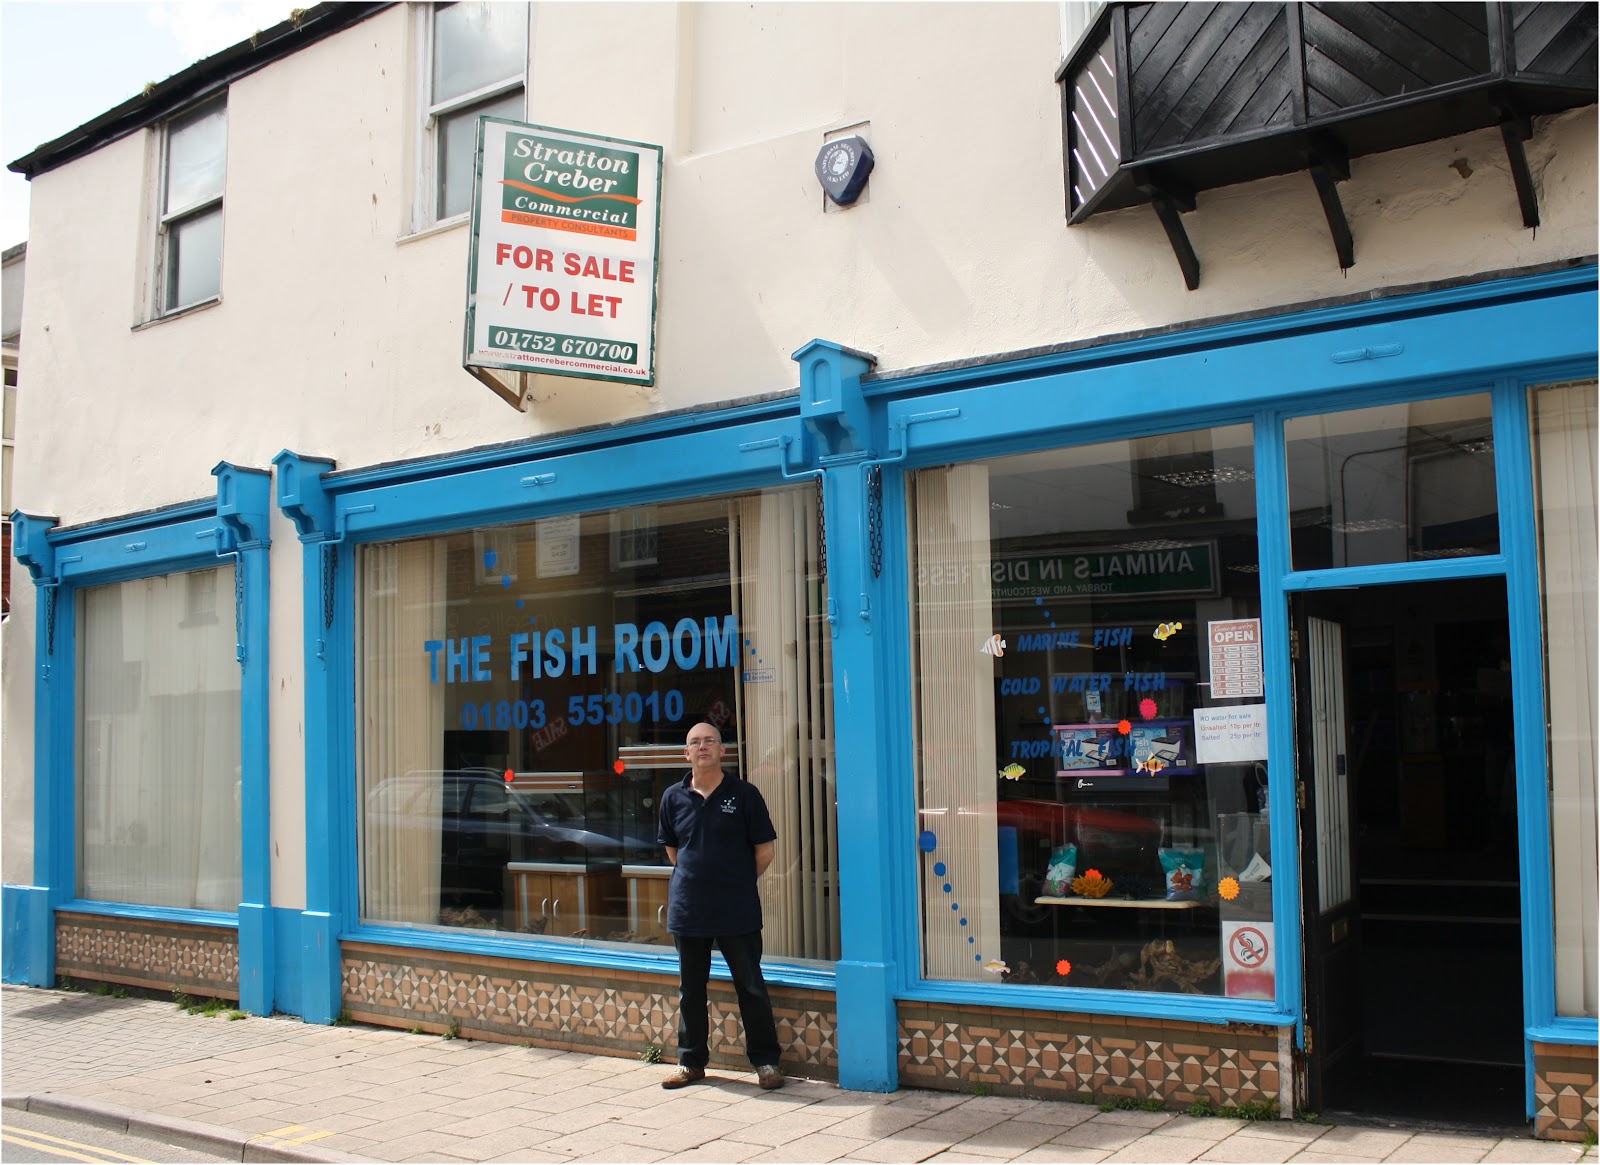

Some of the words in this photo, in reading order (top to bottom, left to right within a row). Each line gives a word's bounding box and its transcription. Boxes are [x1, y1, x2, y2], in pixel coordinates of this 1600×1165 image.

[513, 138, 629, 174] Stratton
[524, 162, 618, 192] Creber
[514, 196, 628, 224] Commercial
[511, 213, 559, 227] PROPERTY
[561, 222, 628, 238] CONSULTANTS
[495, 243, 554, 273] FOR
[564, 252, 635, 283] SALE
[502, 282, 513, 306] /
[521, 285, 560, 311] TO
[570, 292, 623, 319] LET
[495, 331, 556, 352] 01752
[561, 338, 633, 361] 670700
[424, 635, 492, 685] THE
[510, 625, 597, 681] FISH
[614, 614, 739, 673] ROOM
[1017, 631, 1080, 652] MARINE
[1094, 627, 1133, 647] FISH
[1214, 630, 1254, 643] OPEN
[1001, 676, 1041, 695] COLD
[1052, 673, 1113, 694] WATER
[1123, 671, 1166, 692] FISH
[462, 699, 547, 731] 01803
[568, 689, 684, 726] 553010
[1011, 739, 1084, 759] TROPICAL
[1098, 737, 1136, 757] FISH
